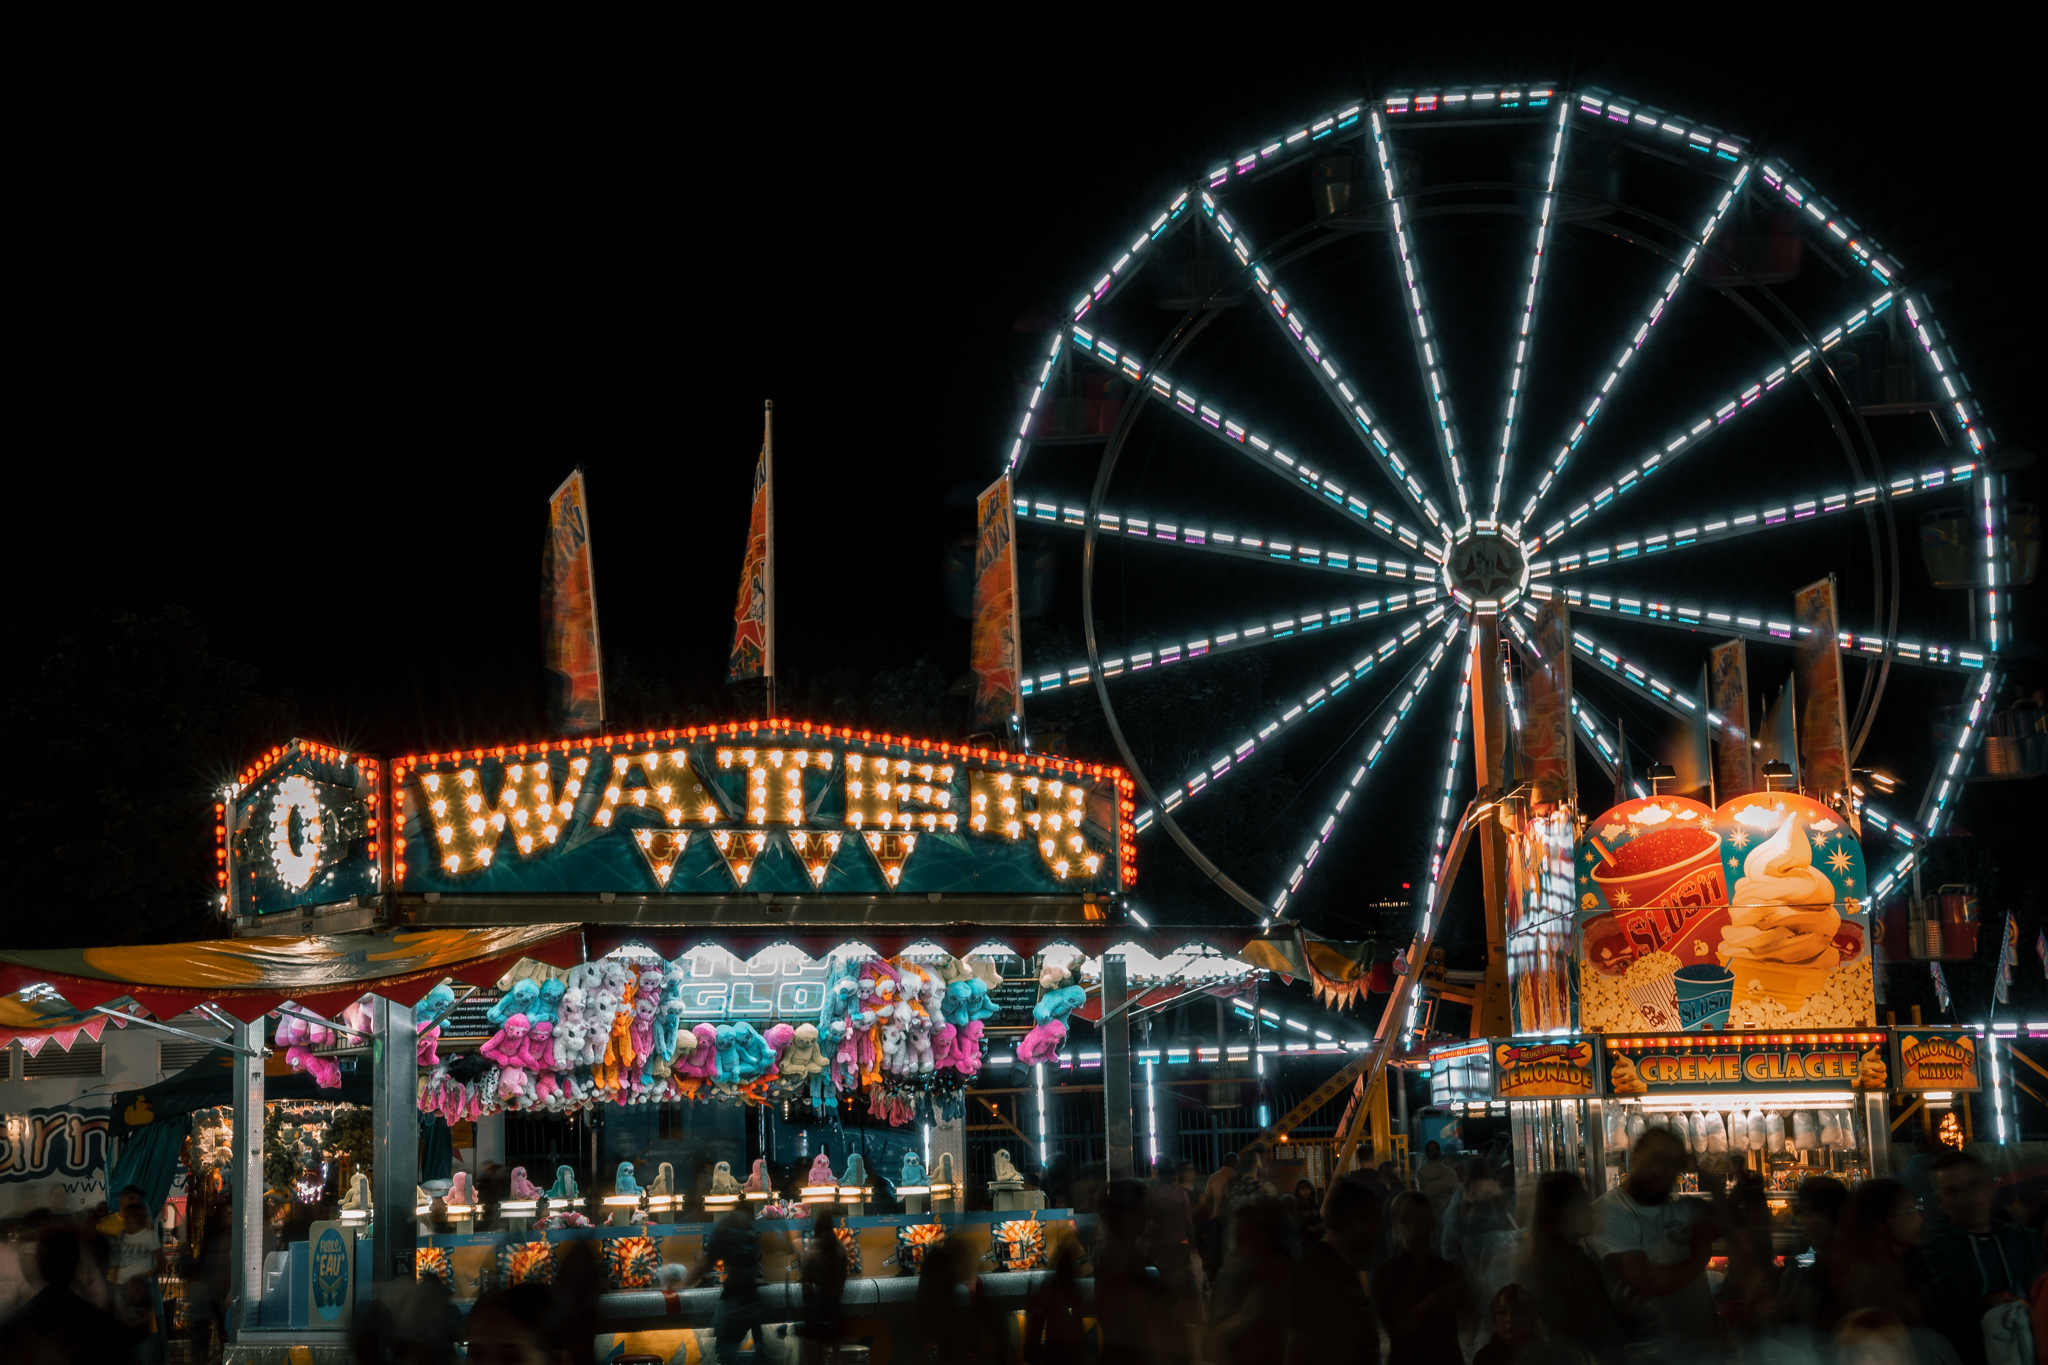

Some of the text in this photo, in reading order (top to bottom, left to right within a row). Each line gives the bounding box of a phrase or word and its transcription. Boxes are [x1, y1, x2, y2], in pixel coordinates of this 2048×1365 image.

[418, 746, 1099, 879] WATER
[1626, 870, 1723, 957] SLUSH
[680, 982, 826, 1013] GLO
[1680, 993, 1729, 1024] SLUSH
[1520, 1045, 1567, 1060] FRESHLY SQUEEZED
[1904, 1038, 1973, 1068] LIMONADE
[1500, 1060, 1592, 1092] LEMONADE
[1637, 1047, 1860, 1085] CRÈME GLACÉE
[1918, 1062, 1964, 1080] MAISON
[839, 1217, 845, 1227] 5
[933, 1214, 941, 1224] 6
[1029, 1210, 1037, 1221] 7
[539, 1231, 547, 1241] 2
[641, 1226, 647, 1237] 3
[320, 1240, 338, 1253] FUSILS
[320, 1254, 340, 1277] EAU
